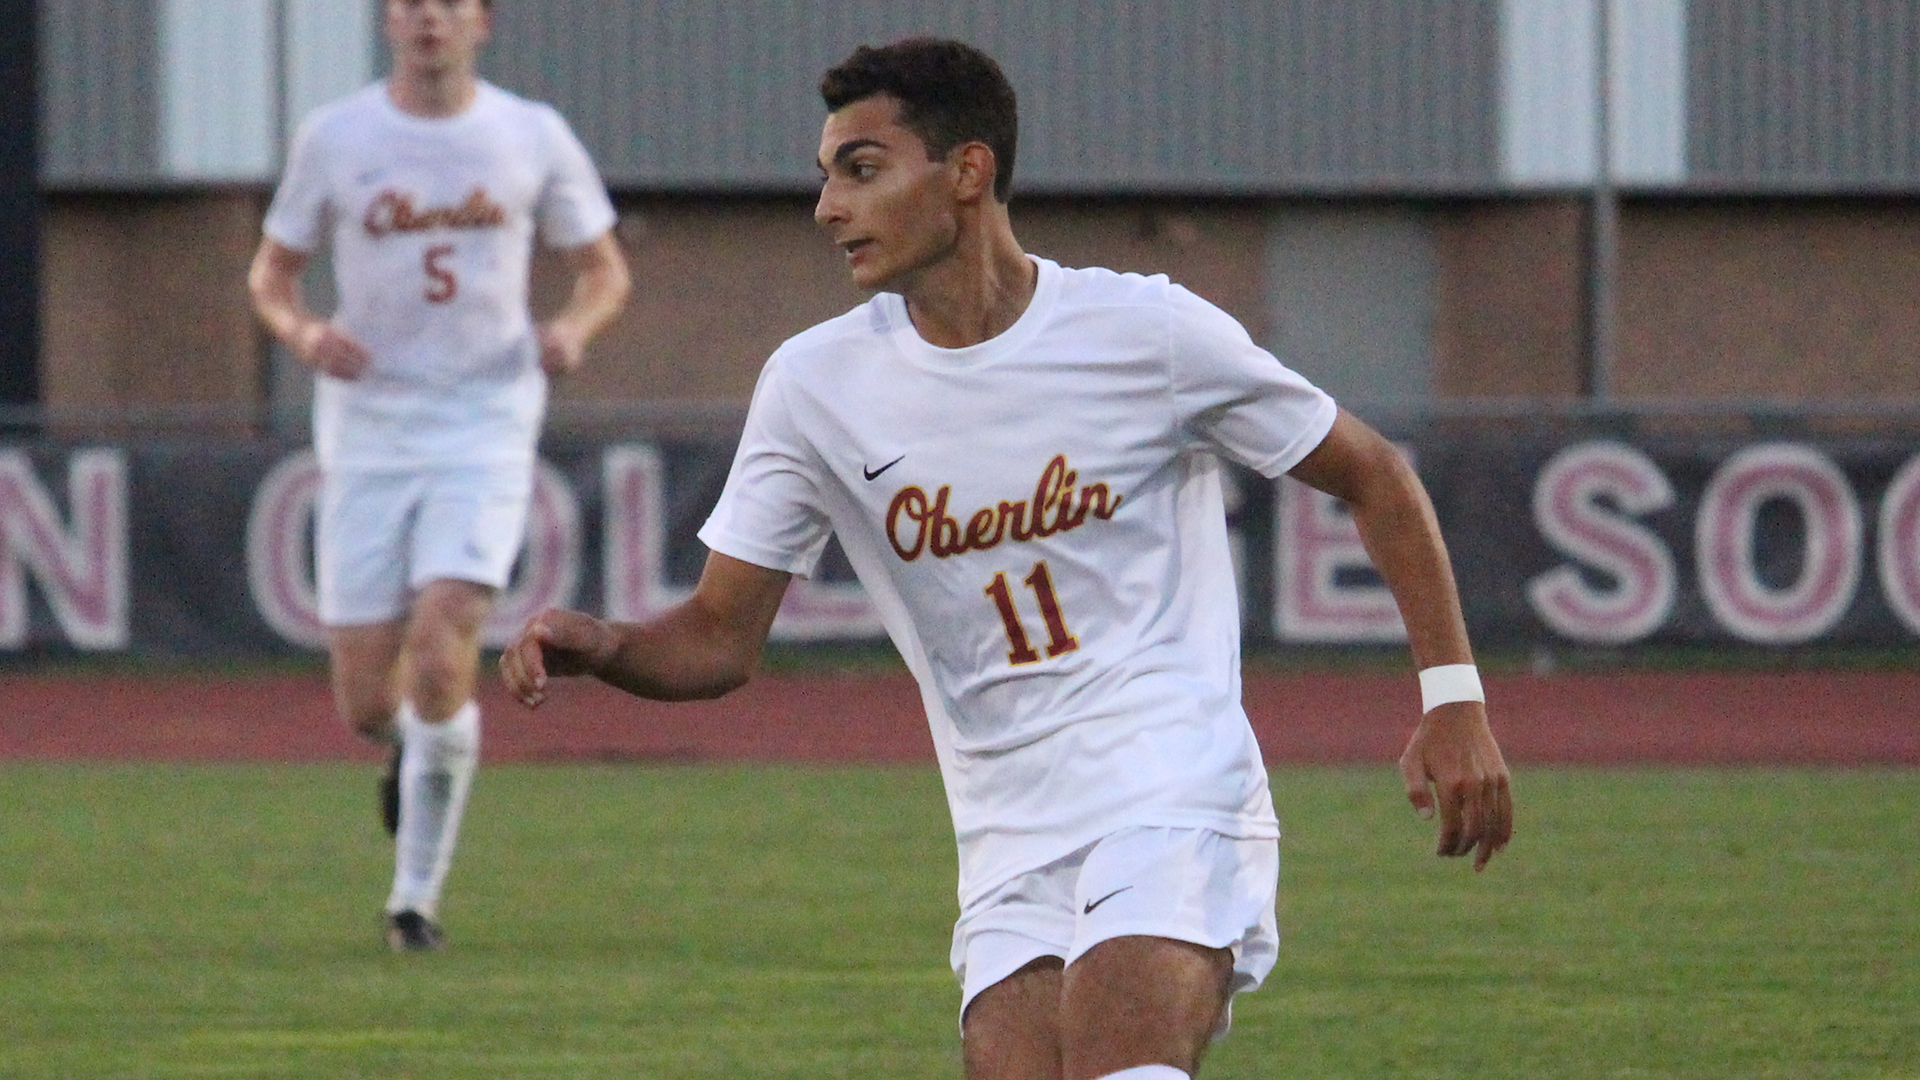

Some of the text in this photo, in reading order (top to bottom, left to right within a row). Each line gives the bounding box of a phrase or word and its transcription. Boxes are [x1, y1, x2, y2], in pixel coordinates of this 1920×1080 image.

[422, 243, 459, 304] 5
[886, 453, 1123, 562] Oberlin
[1530, 441, 1920, 646] SO
[984, 560, 1079, 667] 11
